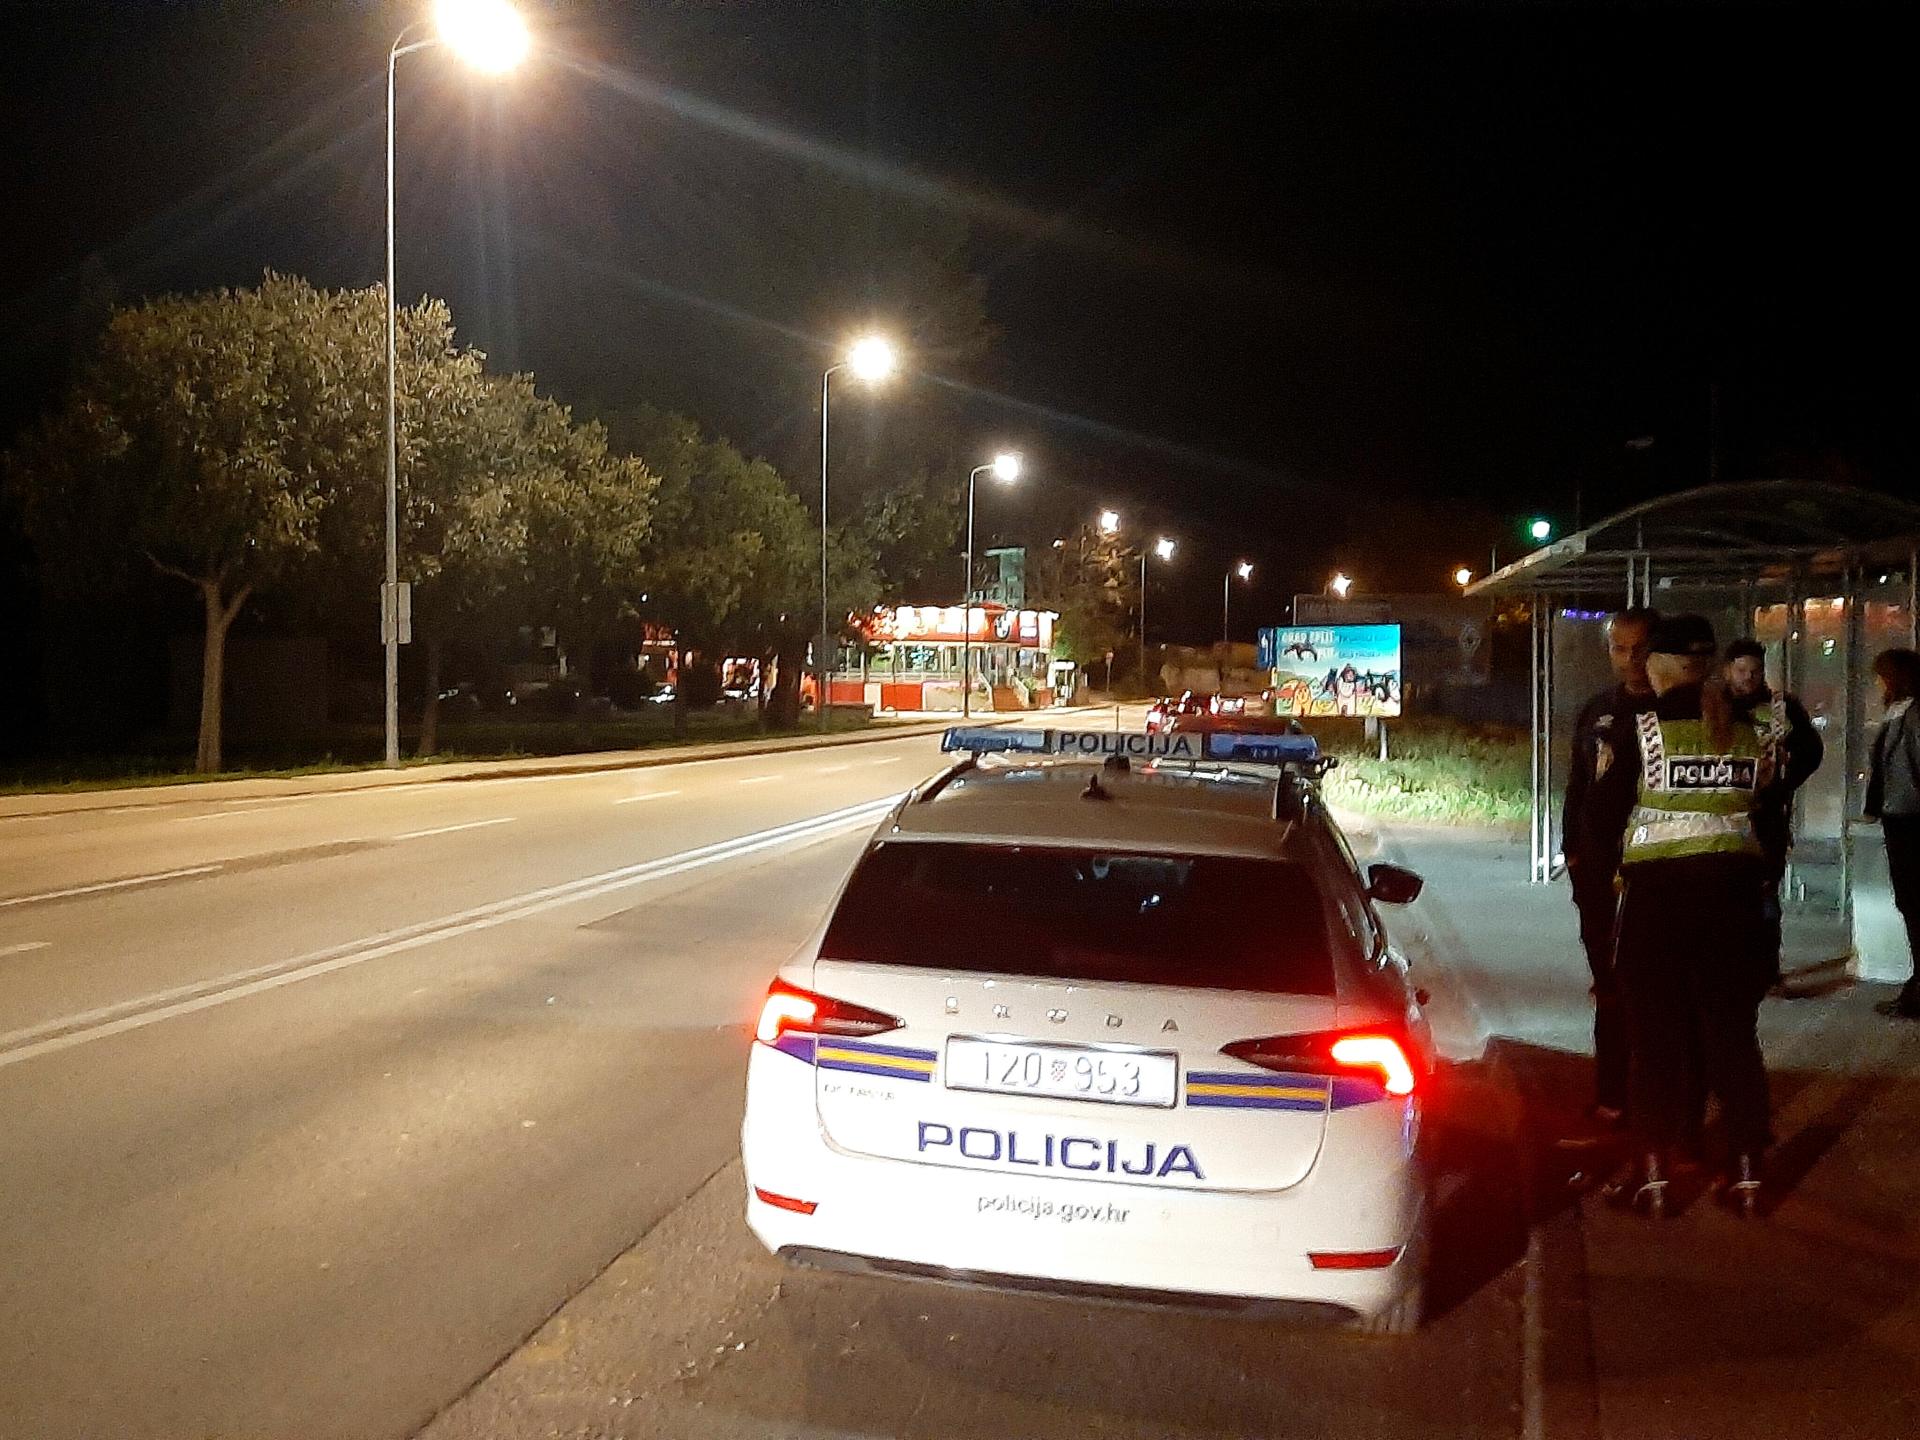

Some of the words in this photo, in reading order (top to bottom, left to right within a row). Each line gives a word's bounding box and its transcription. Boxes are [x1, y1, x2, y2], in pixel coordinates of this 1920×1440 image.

[1060, 732, 1192, 754] POLICIJA
[918, 1120, 1205, 1179] POLICIJA
[978, 1194, 1130, 1223] policija.gov.hr
